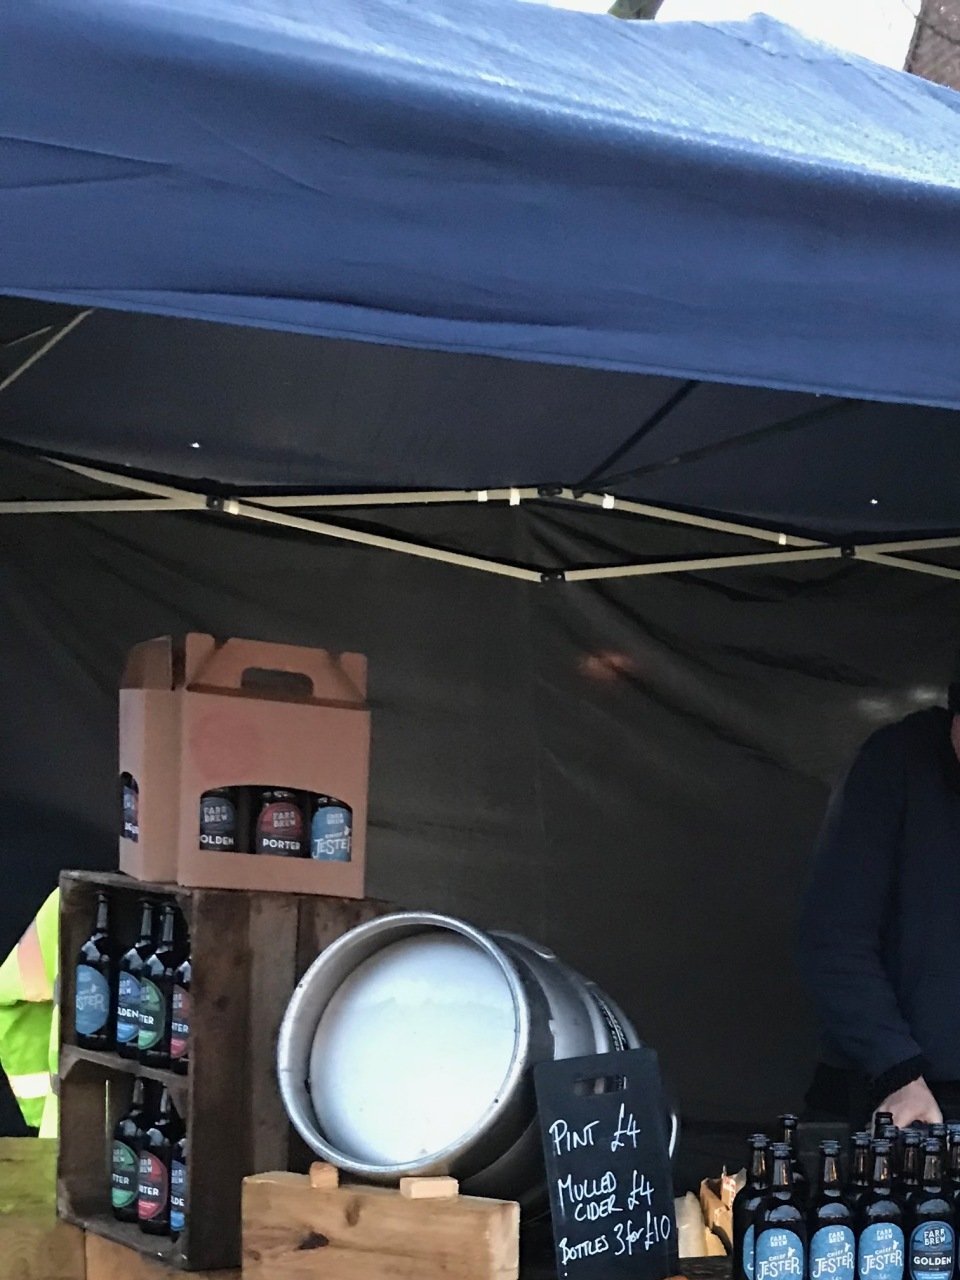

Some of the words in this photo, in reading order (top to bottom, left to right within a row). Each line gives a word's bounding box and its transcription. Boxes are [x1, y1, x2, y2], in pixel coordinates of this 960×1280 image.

[204, 814, 228, 823] BREW
[273, 819, 296, 828] BREW
[199, 833, 235, 846] OLDEN
[262, 838, 301, 851] PORTER
[549, 1119, 600, 1155] PINT
[611, 1103, 641, 1152] £4
[557, 1171, 617, 1210] MULLED
[575, 1194, 623, 1222] CIDER
[628, 1170, 655, 1211] £4
[559, 1235, 610, 1264] BOTTLES
[614, 1223, 625, 1256] 3
[645, 1211, 672, 1251] £10
[923, 1228, 945, 1238] FARR
[924, 1237, 946, 1246] BREW
[757, 1256, 802, 1280] JESTER
[812, 1252, 854, 1278] JESTER
[861, 1249, 903, 1275] JESTER
[913, 1256, 952, 1266] GOLDEN
